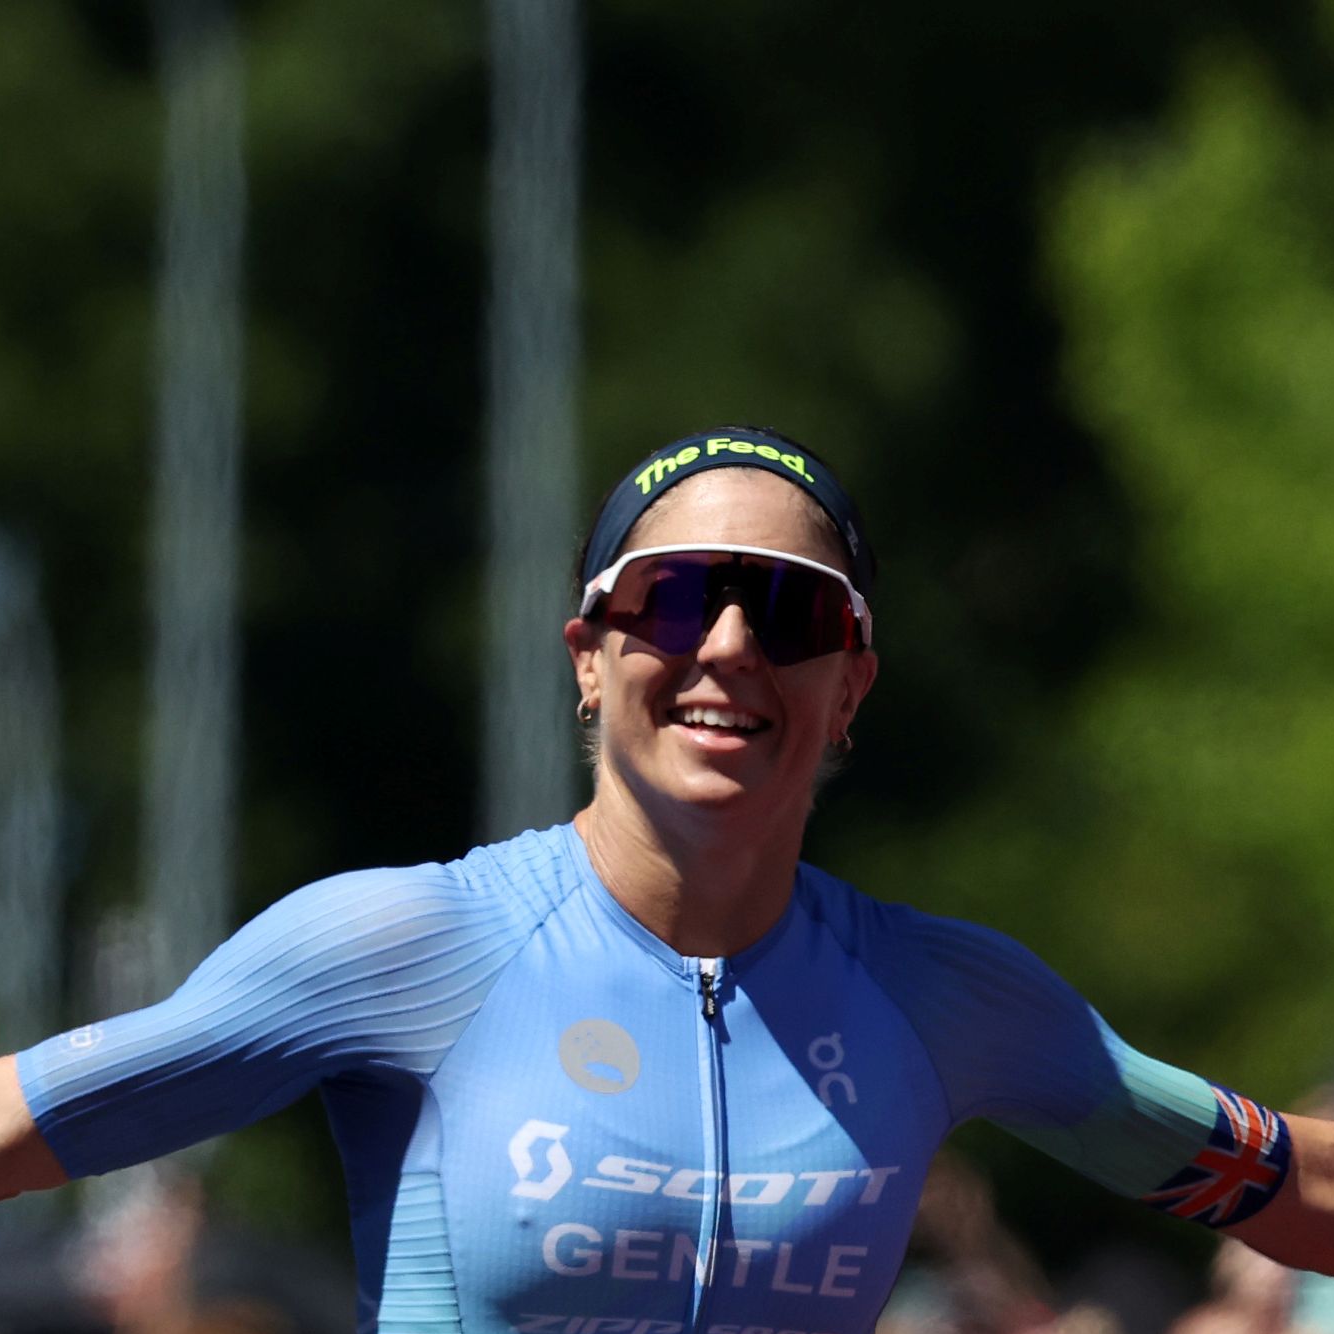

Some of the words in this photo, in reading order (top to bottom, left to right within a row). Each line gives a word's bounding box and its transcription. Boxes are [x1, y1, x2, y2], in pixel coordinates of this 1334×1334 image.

[634, 446, 701, 495] The
[706, 437, 815, 483] Feed.
[581, 1154, 900, 1206] SCOTT
[542, 1221, 869, 1298] GENTLE
